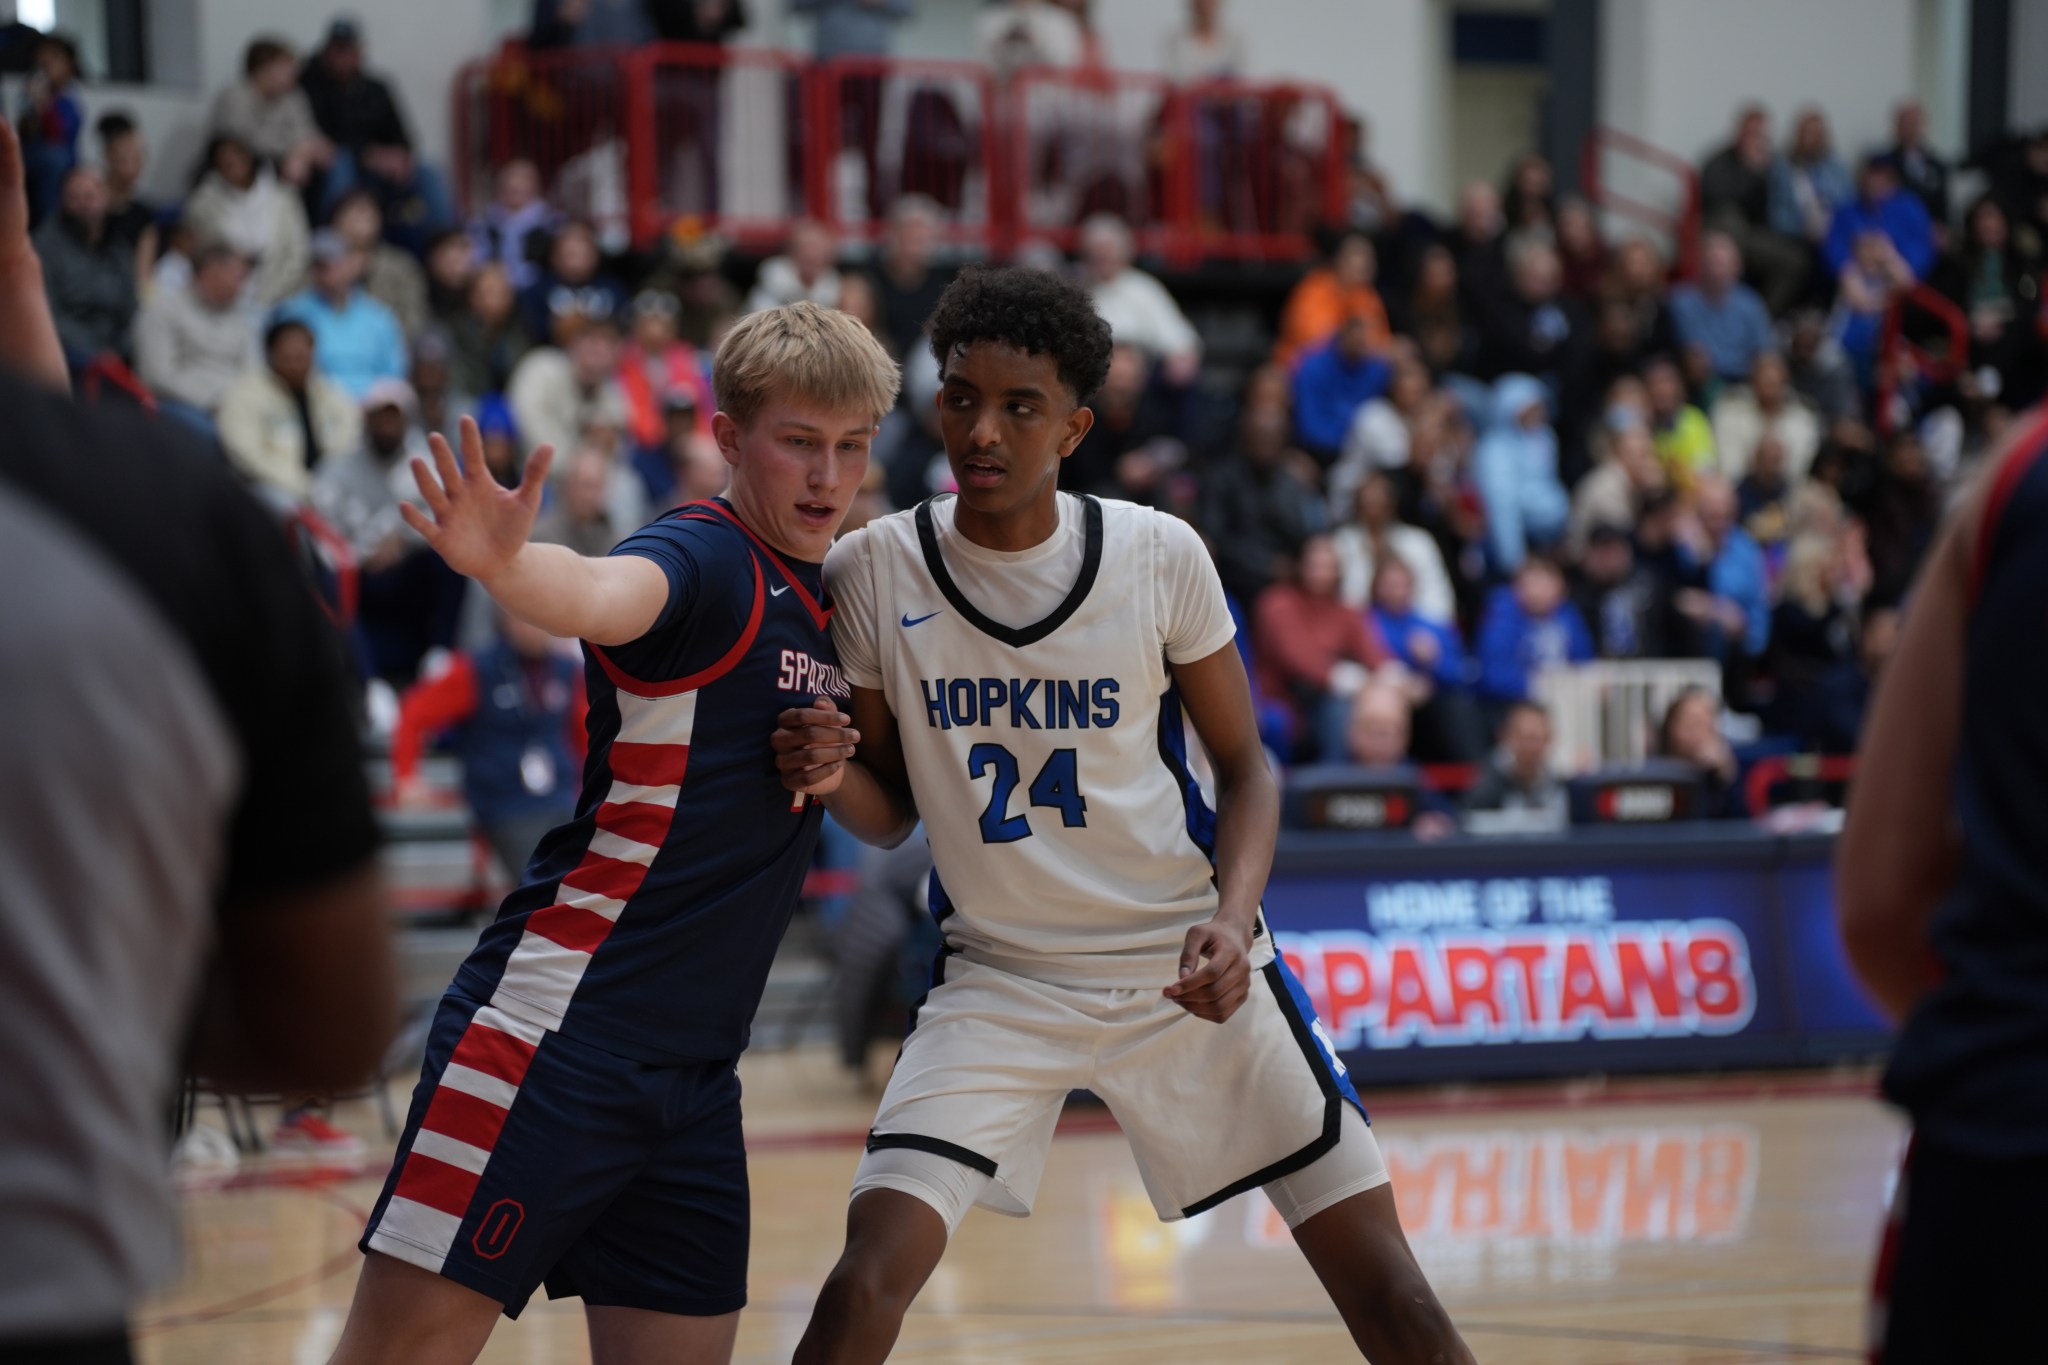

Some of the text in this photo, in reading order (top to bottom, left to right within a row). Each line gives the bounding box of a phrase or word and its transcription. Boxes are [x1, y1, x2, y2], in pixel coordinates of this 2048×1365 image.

[920, 677, 1120, 730] HOPKINS
[967, 742, 1088, 844] 24
[1366, 880, 1479, 931] HOME
